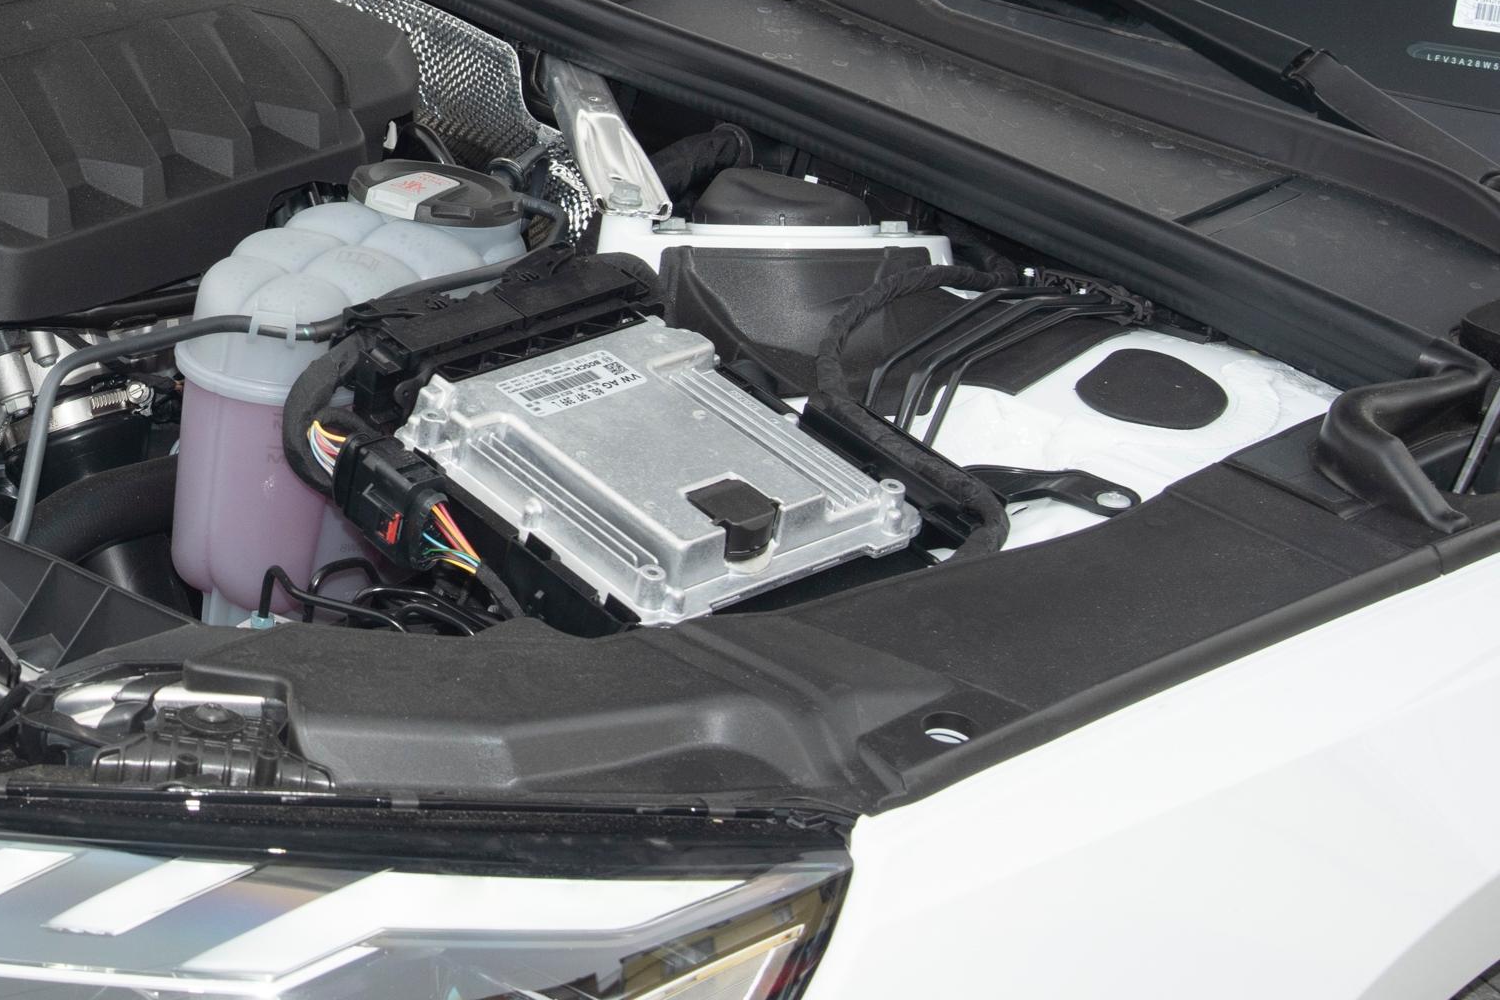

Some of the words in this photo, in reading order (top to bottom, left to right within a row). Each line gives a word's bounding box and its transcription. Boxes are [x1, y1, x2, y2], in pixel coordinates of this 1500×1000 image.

[1426, 53, 1500, 70] LFV3A28W5
[575, 359, 602, 372] BOSCH
[602, 379, 620, 389] AG
[621, 373, 641, 384] VW
